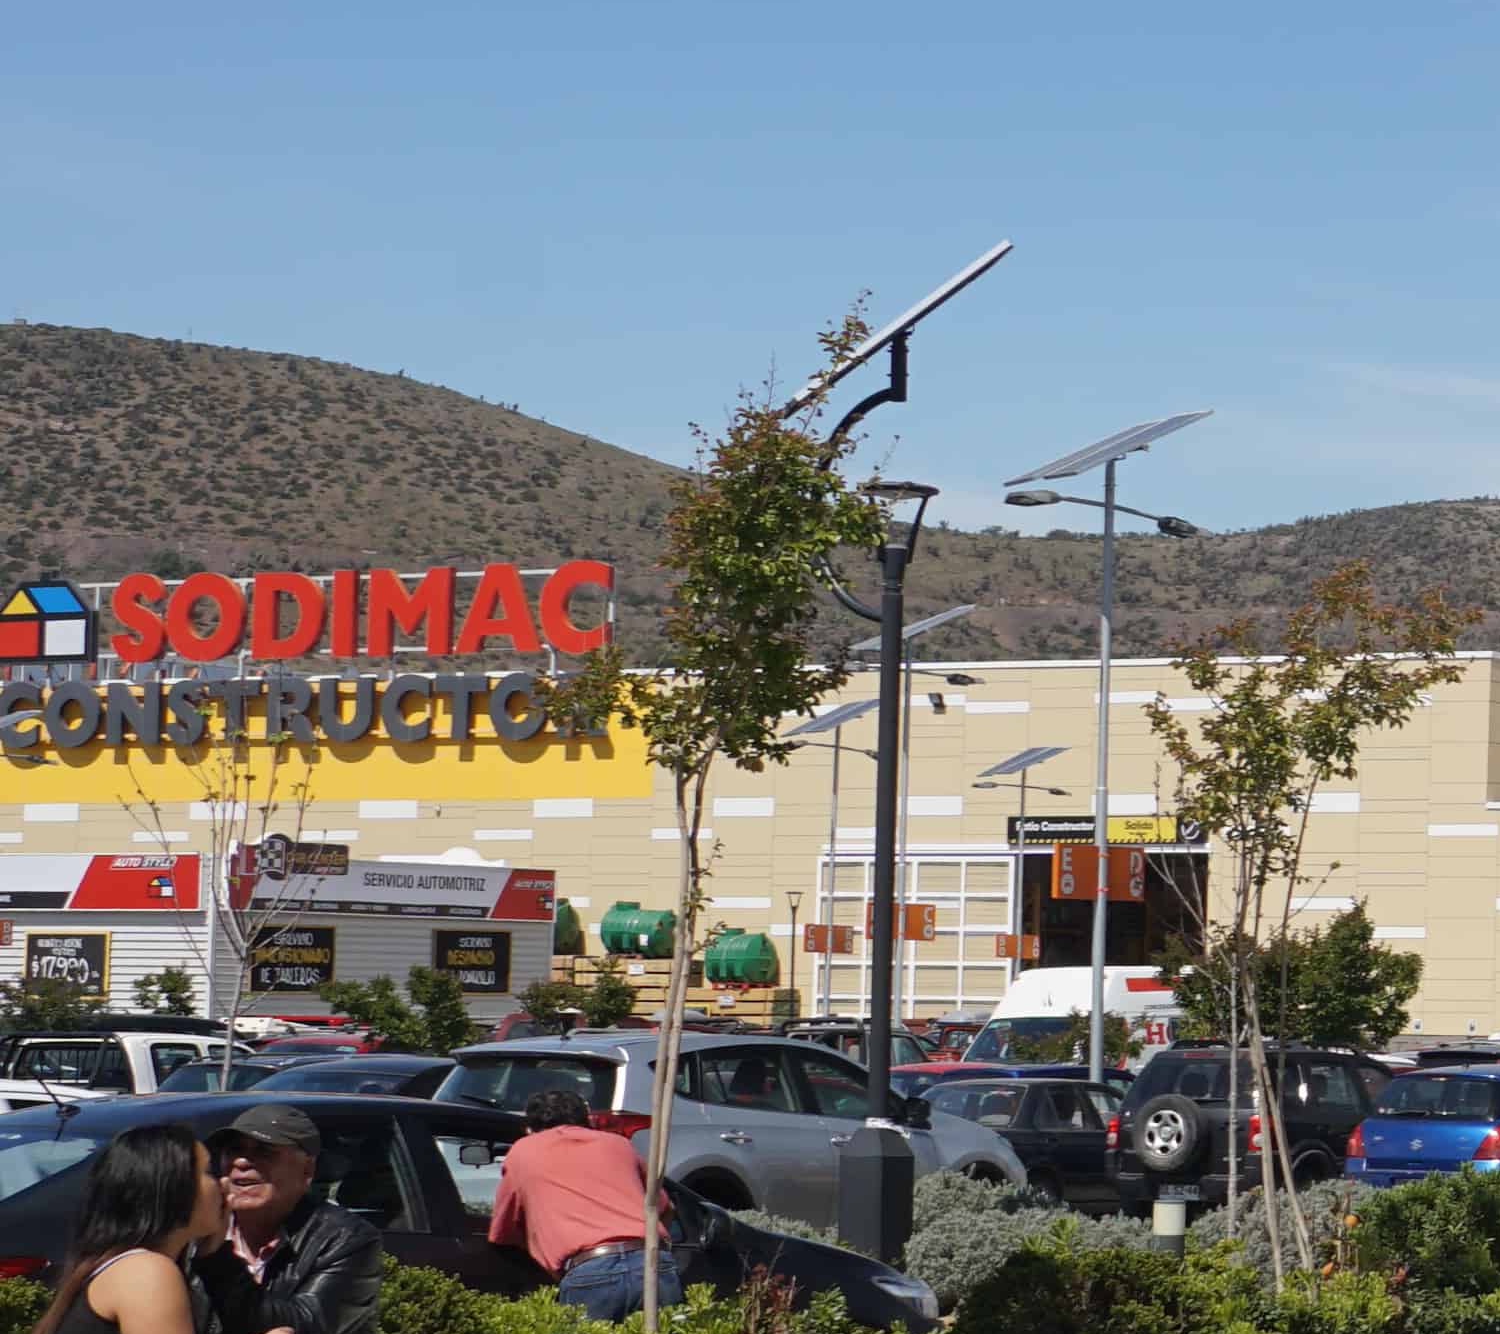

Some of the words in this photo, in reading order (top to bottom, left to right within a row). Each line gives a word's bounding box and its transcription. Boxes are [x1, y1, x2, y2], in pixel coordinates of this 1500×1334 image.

[110, 560, 615, 663] SODIMAC
[1061, 848, 1073, 871] E
[363, 873, 414, 889] SERVICIO
[416, 875, 486, 891] AUTOMOTRIZ
